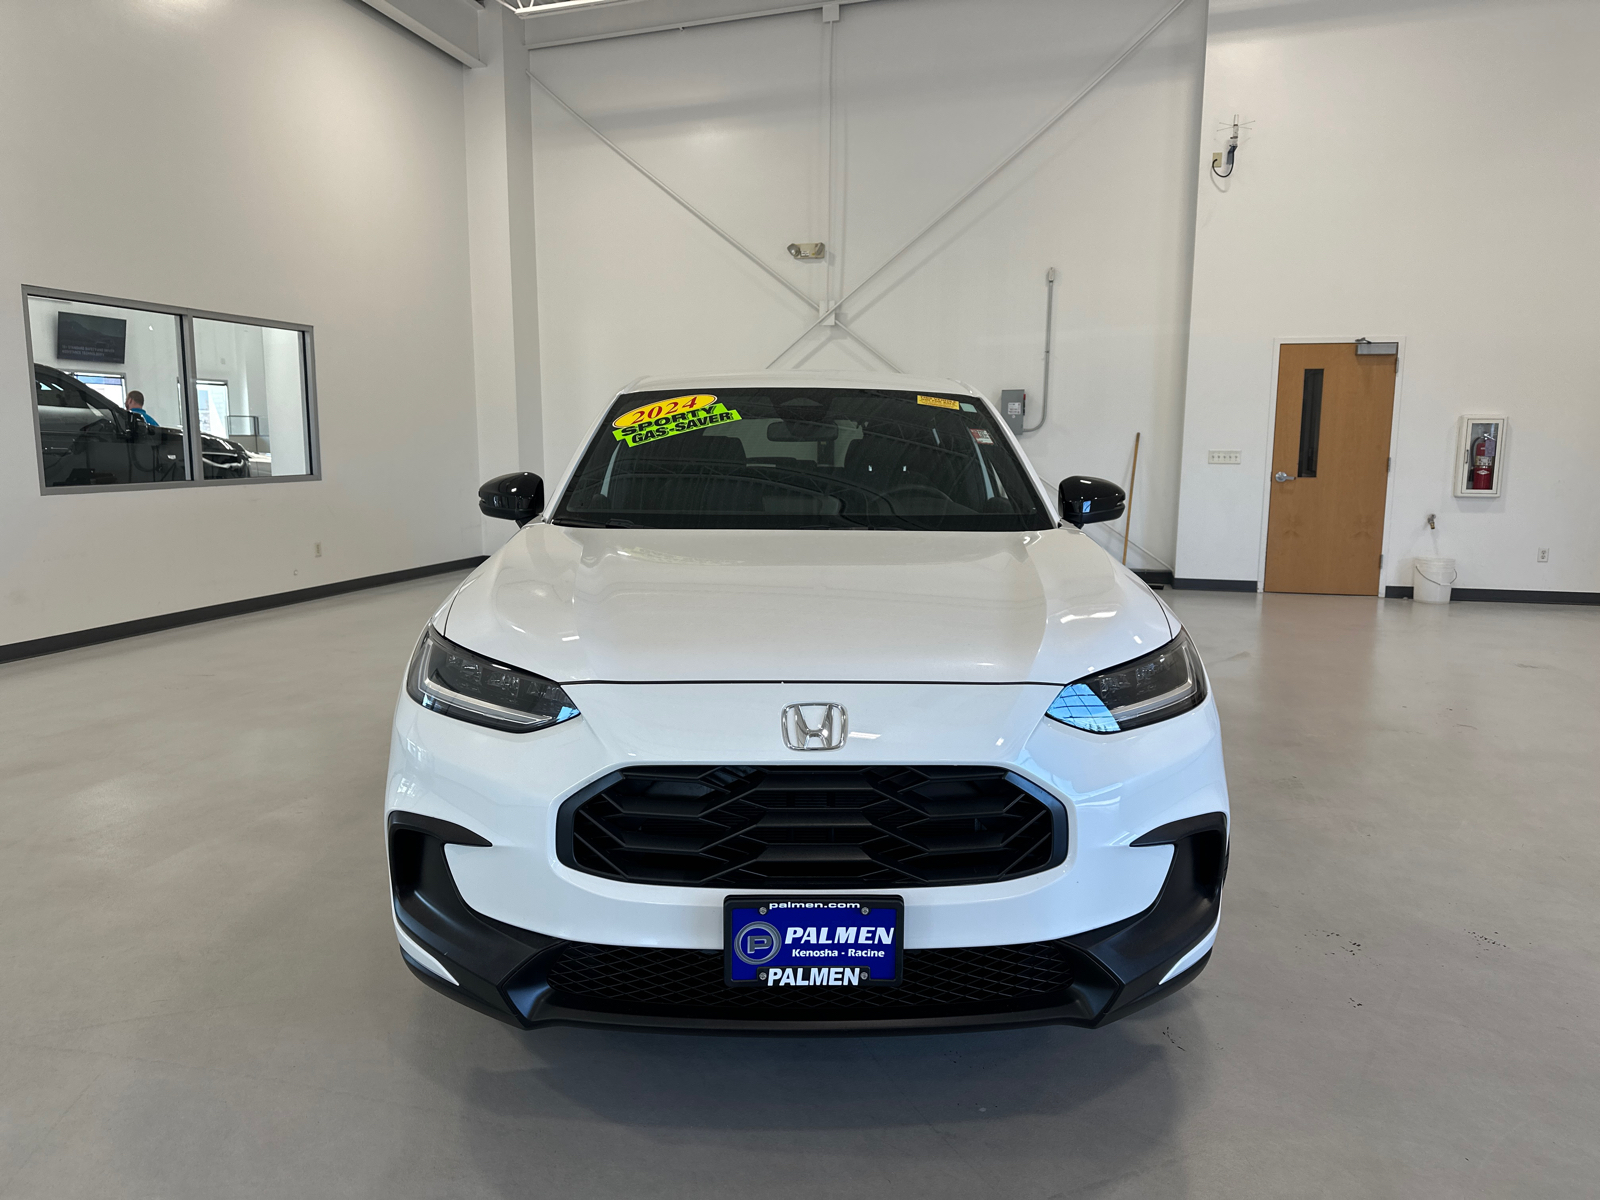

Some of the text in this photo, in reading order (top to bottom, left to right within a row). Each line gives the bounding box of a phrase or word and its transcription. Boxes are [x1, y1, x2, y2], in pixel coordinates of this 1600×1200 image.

[630, 396, 698, 425] 2024
[621, 405, 717, 437] SPORTY
[631, 411, 733, 443] GAS-SAVER
[769, 901, 860, 910] palmen.com
[784, 926, 894, 945] PALMEN
[792, 948, 839, 958] Kenosha
[848, 948, 885, 958] Racine
[767, 967, 860, 987] PALMEN
